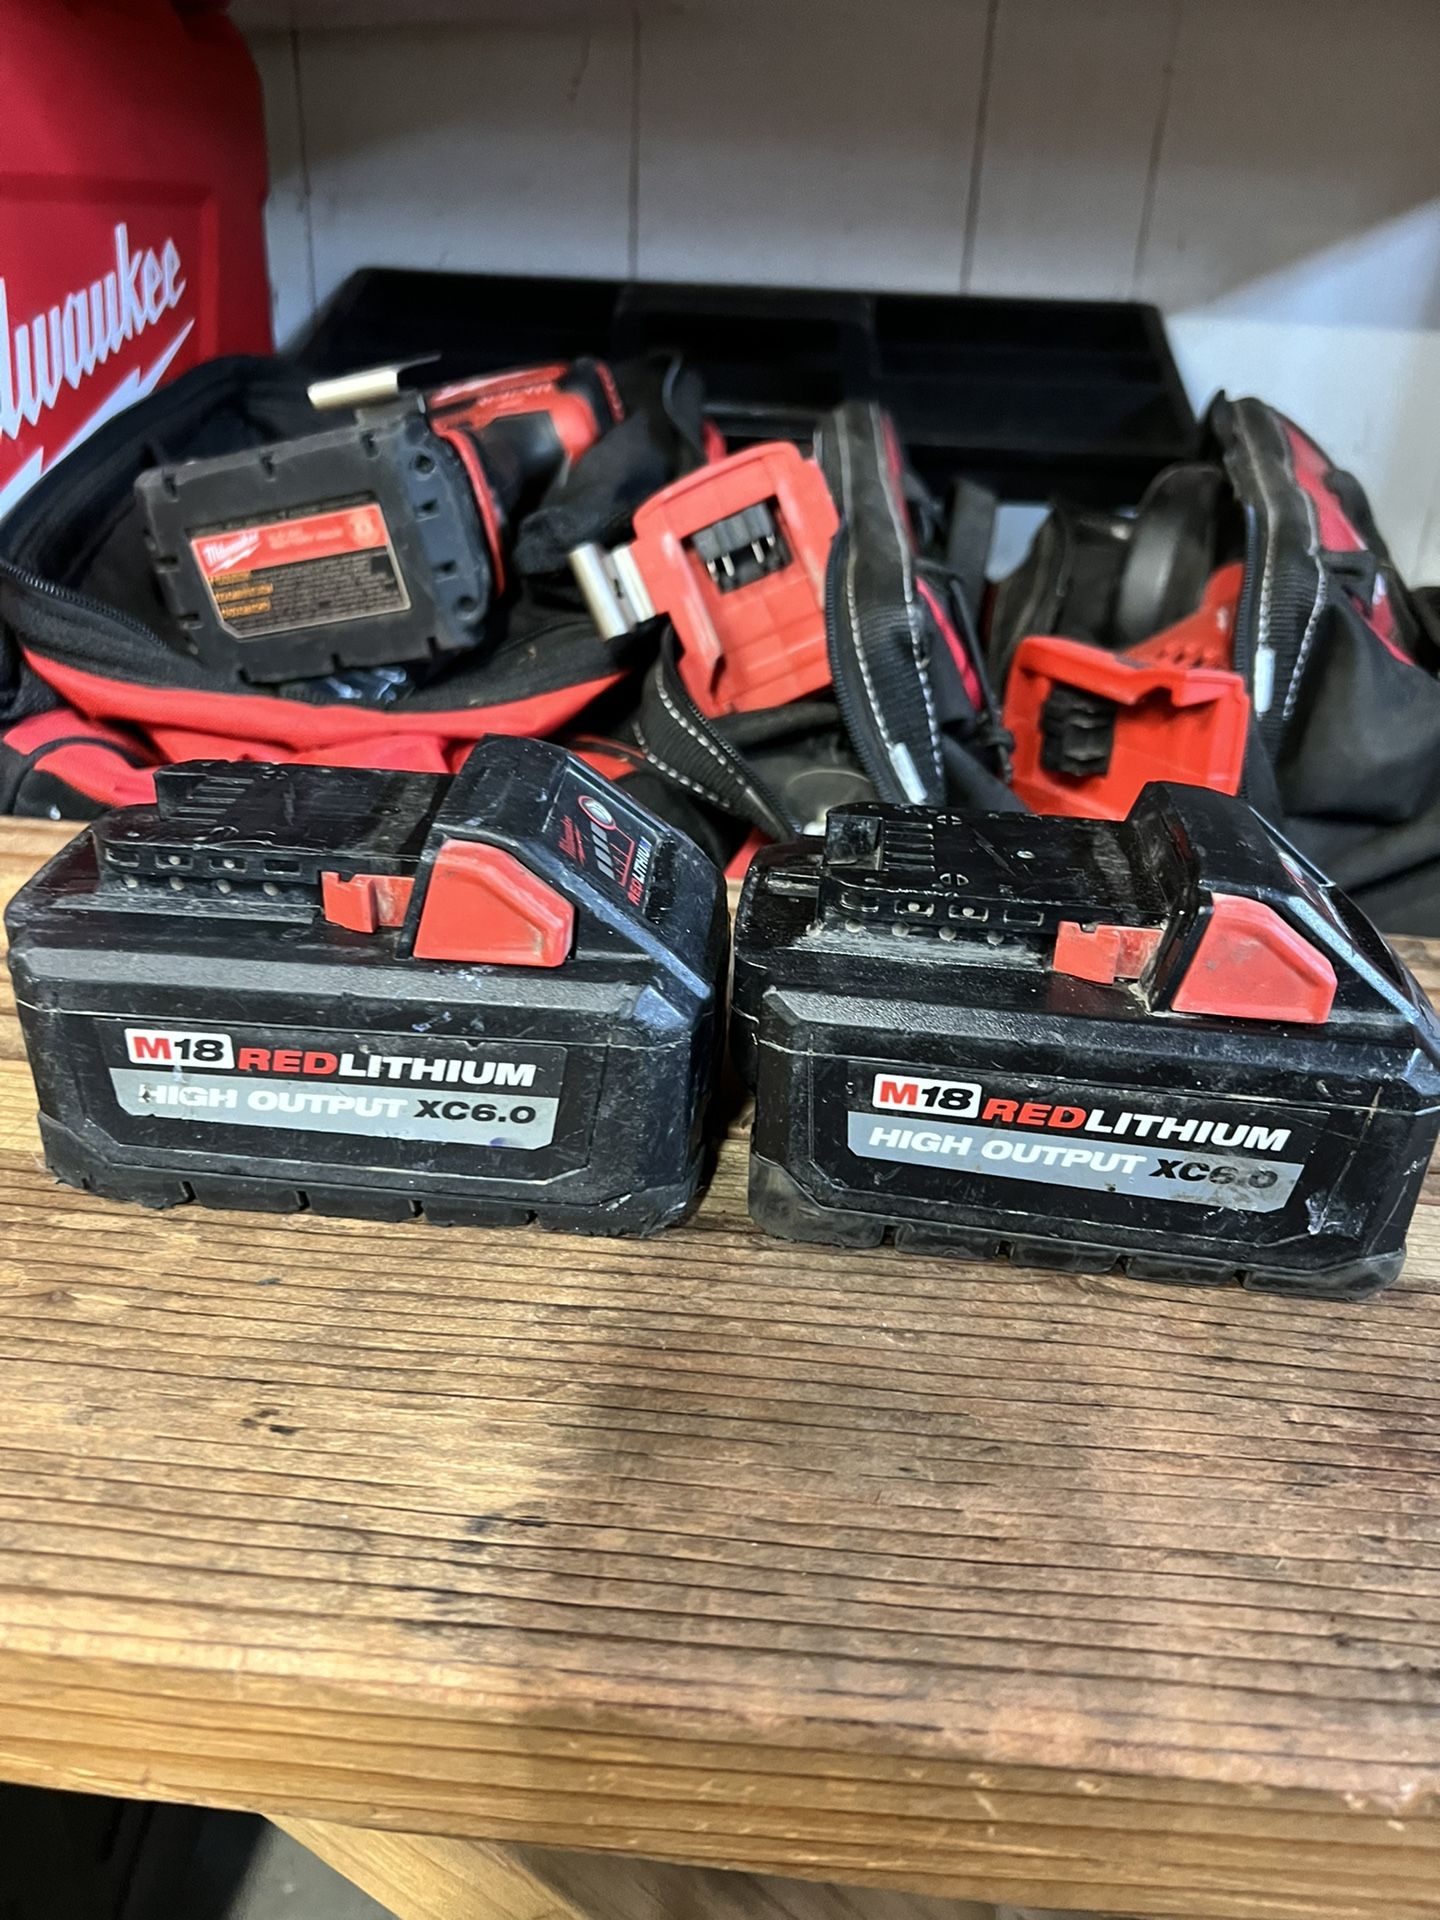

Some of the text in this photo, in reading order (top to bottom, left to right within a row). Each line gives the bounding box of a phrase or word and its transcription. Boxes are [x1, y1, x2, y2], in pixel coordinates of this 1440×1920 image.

[0, 222, 186, 440] lwaukee
[133, 1036, 536, 1087] M18 REDLITHIUM
[139, 1084, 537, 1124] HIGH OUTPUT XC6.0
[879, 1081, 1292, 1152] M18 REDLITHIUM
[868, 1127, 1279, 1189] HIGH OUTPUT XC60
